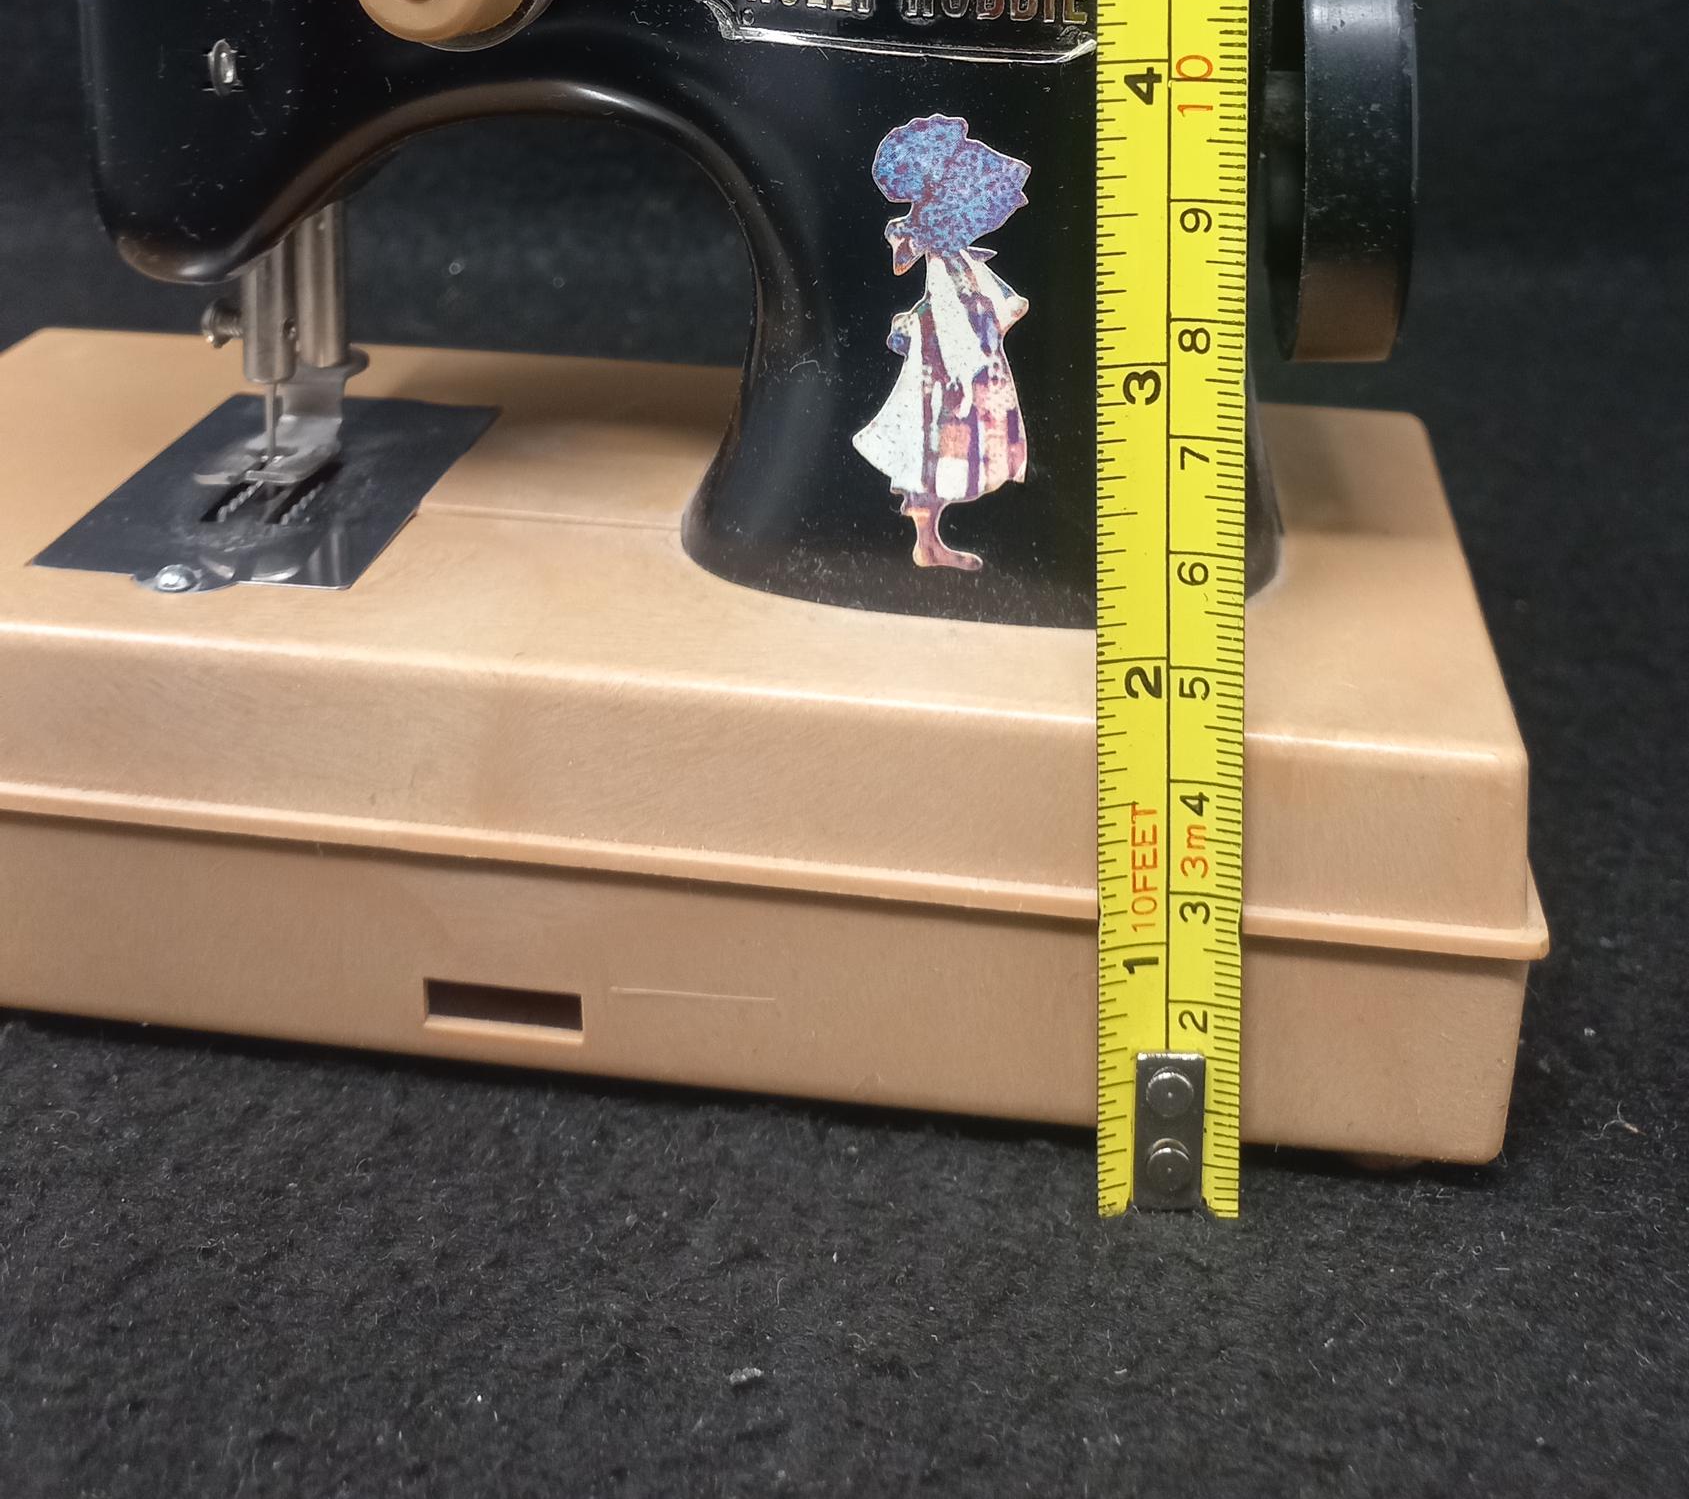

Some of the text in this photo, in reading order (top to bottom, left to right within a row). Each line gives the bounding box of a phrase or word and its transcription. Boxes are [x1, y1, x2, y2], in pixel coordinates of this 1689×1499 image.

[1123, 67, 1162, 105] 4
[1180, 207, 1212, 233] 9
[1178, 328, 1211, 354] 8
[1122, 370, 1162, 406] 3
[1180, 446, 1211, 470] 7
[1178, 560, 1210, 585] 6
[1124, 666, 1163, 700] 2
[1179, 678, 1210, 700] 5
[1179, 791, 1210, 816] 4
[1179, 901, 1210, 924] 3
[1122, 956, 1159, 974] 1
[1178, 1010, 1208, 1033] 2
